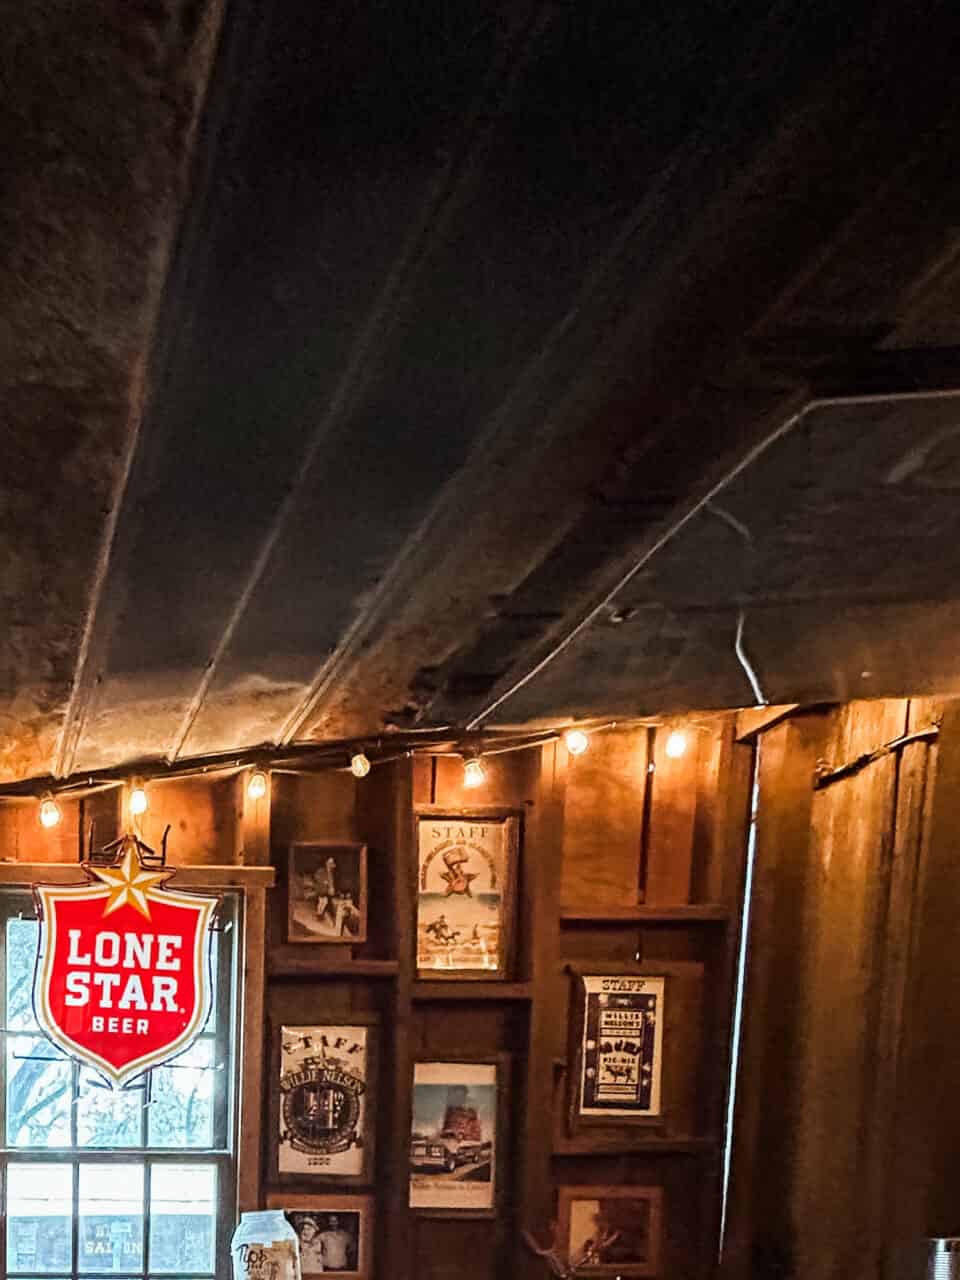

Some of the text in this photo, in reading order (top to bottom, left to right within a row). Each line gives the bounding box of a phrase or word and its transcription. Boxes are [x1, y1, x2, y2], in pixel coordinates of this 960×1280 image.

[431, 826, 489, 838] STAFF
[66, 929, 182, 971] LONE
[64, 971, 179, 1013] STAR
[602, 980, 646, 991] STAFF
[91, 1016, 150, 1036] BEER
